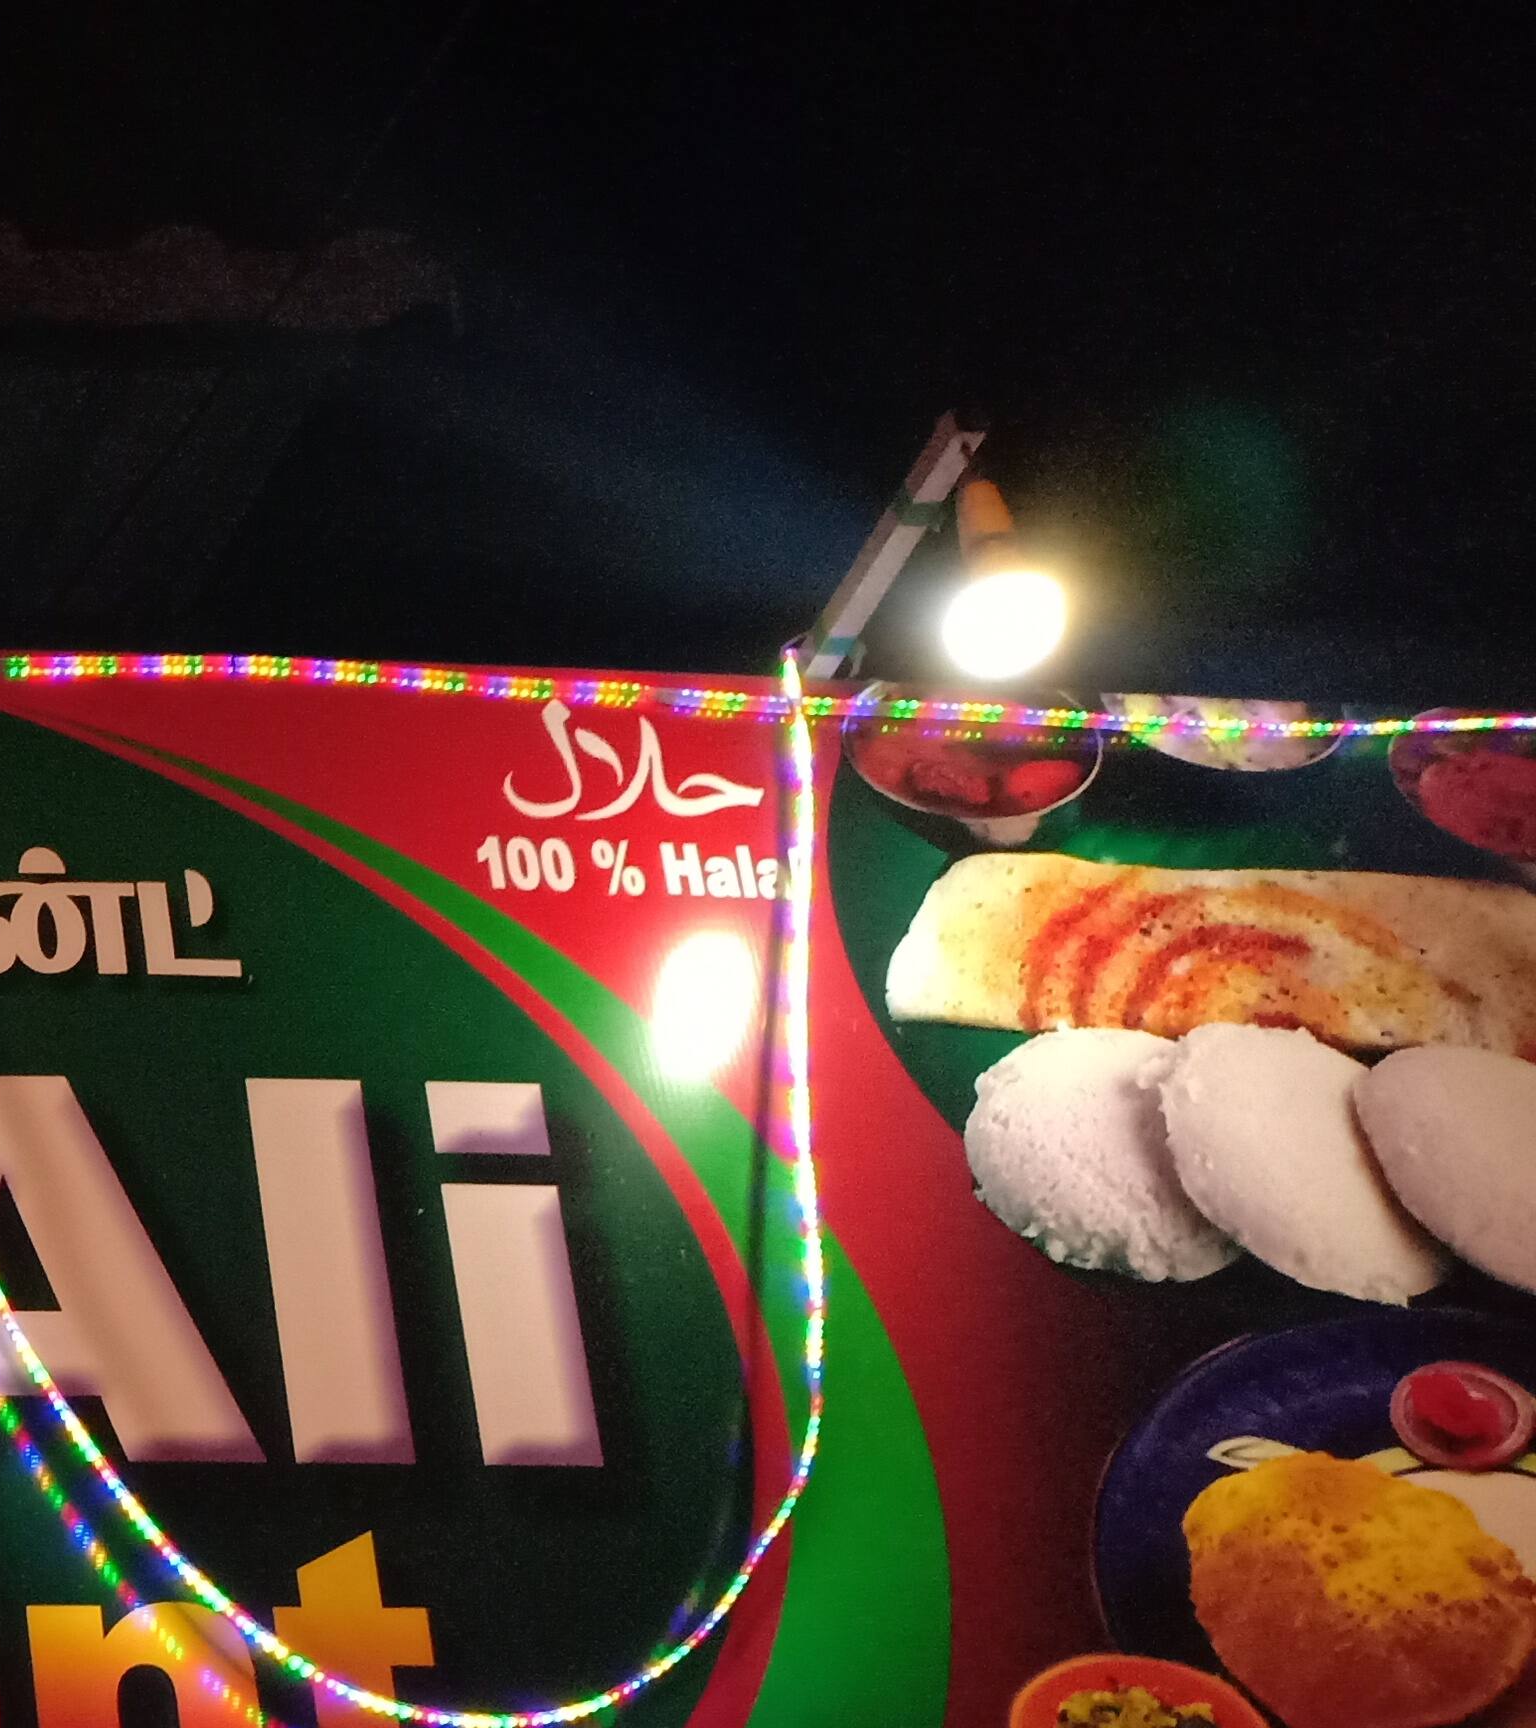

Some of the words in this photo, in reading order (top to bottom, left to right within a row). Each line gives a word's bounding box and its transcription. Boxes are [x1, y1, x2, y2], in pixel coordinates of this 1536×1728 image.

[503, 699, 764, 821] حلال
[476, 836, 575, 892] 100
[591, 839, 646, 896] %
